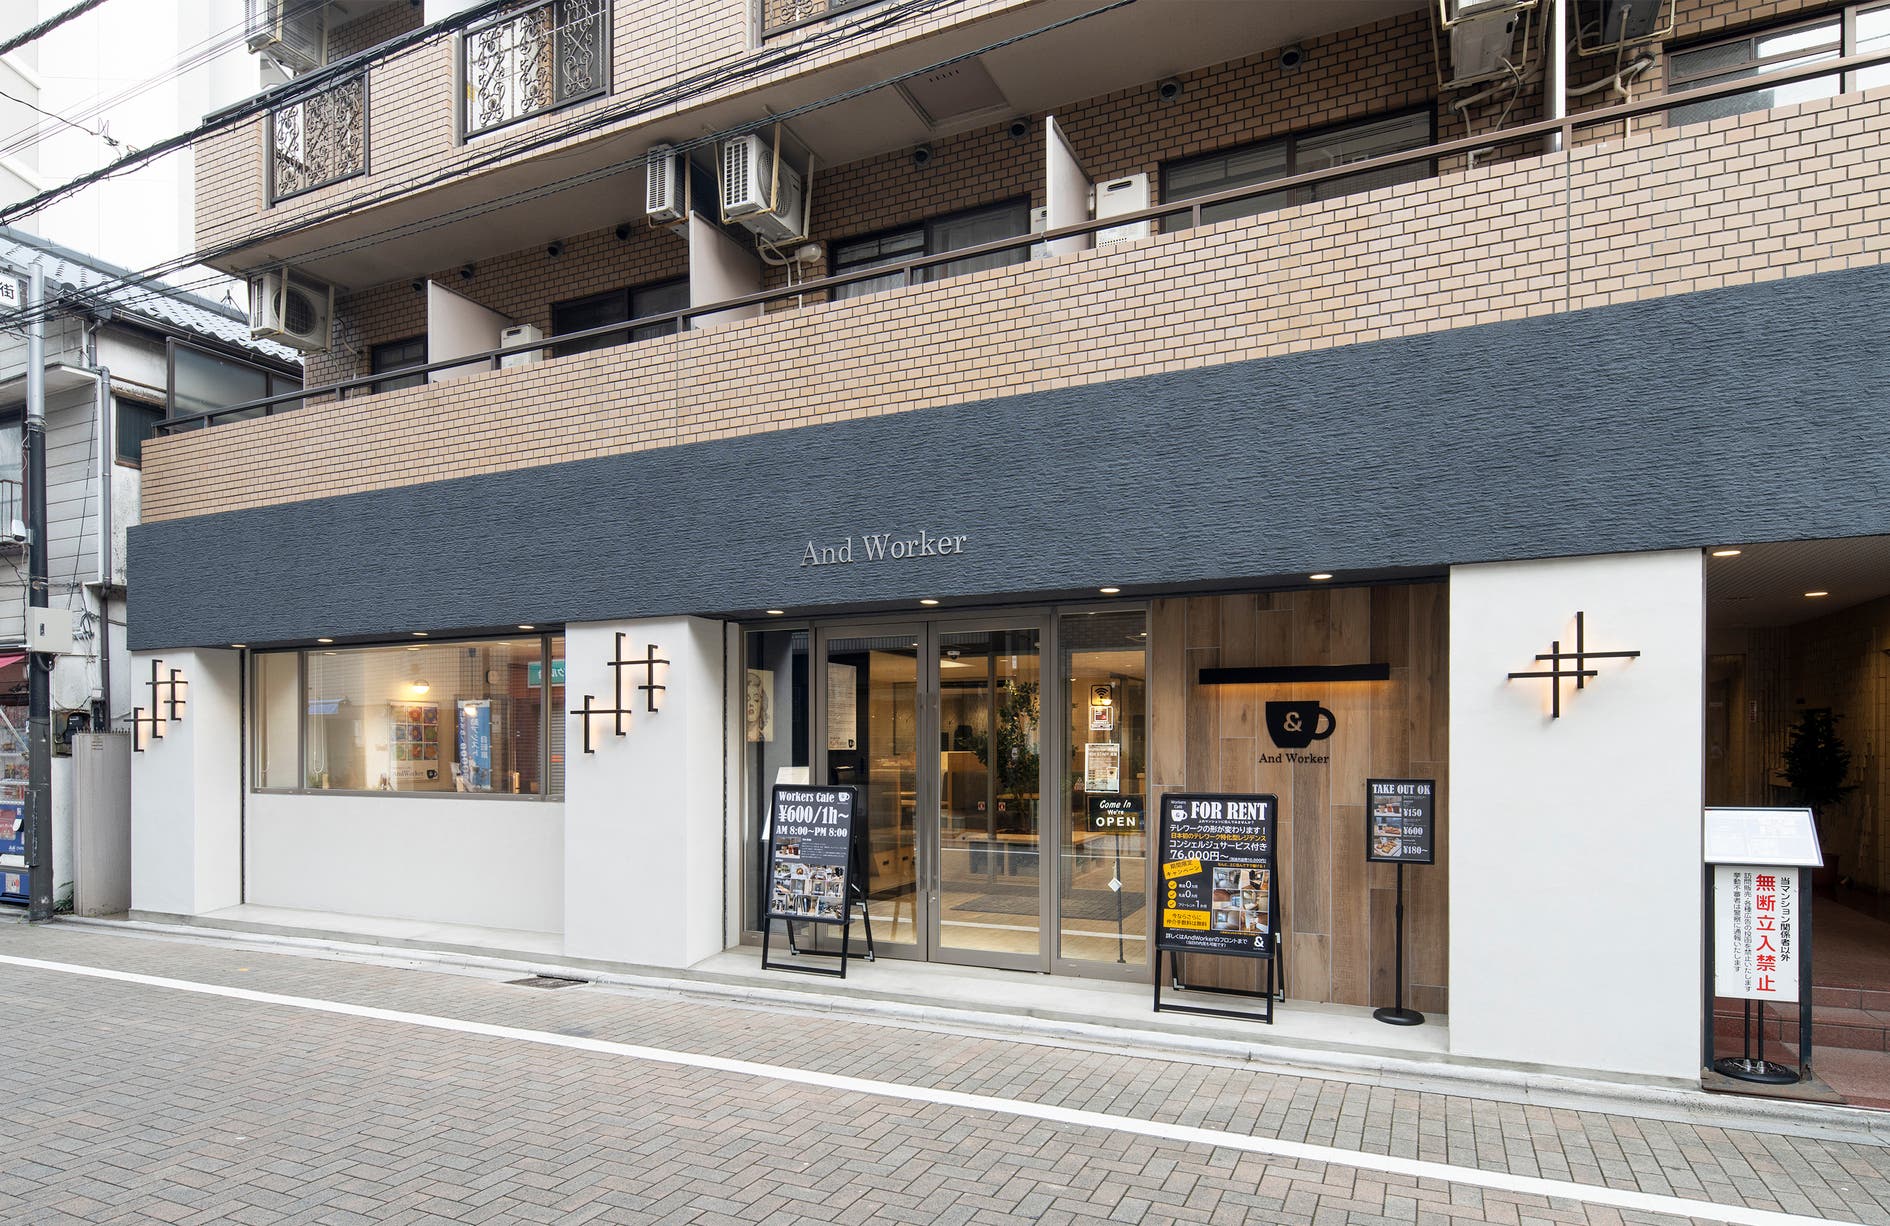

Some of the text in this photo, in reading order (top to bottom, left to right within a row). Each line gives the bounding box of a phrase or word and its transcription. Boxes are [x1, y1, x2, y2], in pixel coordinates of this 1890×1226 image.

[0, 282, 15, 300] 街
[800, 531, 967, 567] And Worker
[1259, 753, 1329, 764] And Worker
[1372, 784, 1430, 794] TAKE OUT OK
[779, 792, 814, 802] Workers
[1100, 800, 1132, 808] Come In
[1190, 801, 1268, 820] FOR RENT
[1404, 808, 1422, 817] ¥150
[1096, 817, 1136, 827] OPEN
[776, 825, 788, 834] AM
[828, 828, 848, 837] 8:00
[1404, 826, 1423, 835] ¥600
[1169, 840, 1268, 851] コンシェルジュサービス付き
[1780, 877, 1790, 962] 当マンション関係者以外
[1756, 874, 1776, 992] 無断立入禁止
